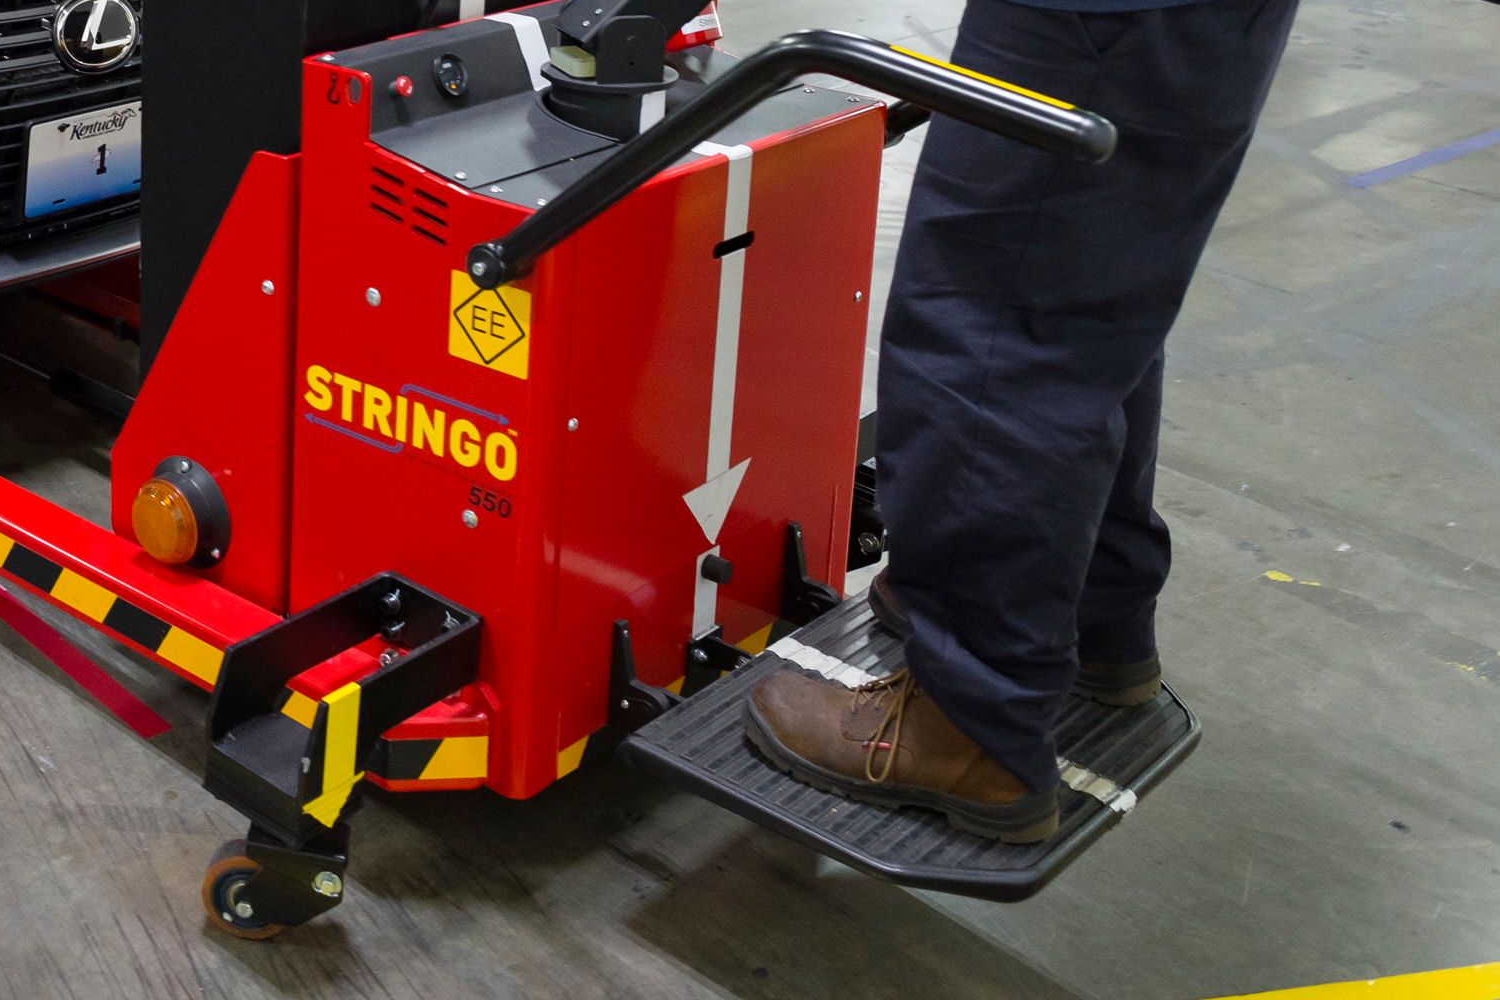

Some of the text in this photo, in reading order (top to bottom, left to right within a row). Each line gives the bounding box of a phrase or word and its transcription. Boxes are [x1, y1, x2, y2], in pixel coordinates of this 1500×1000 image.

[69, 114, 128, 141] Kentucky
[96, 143, 107, 175] 1
[471, 304, 506, 340] EE
[304, 364, 517, 481] STRINGO
[467, 486, 512, 518] 550
